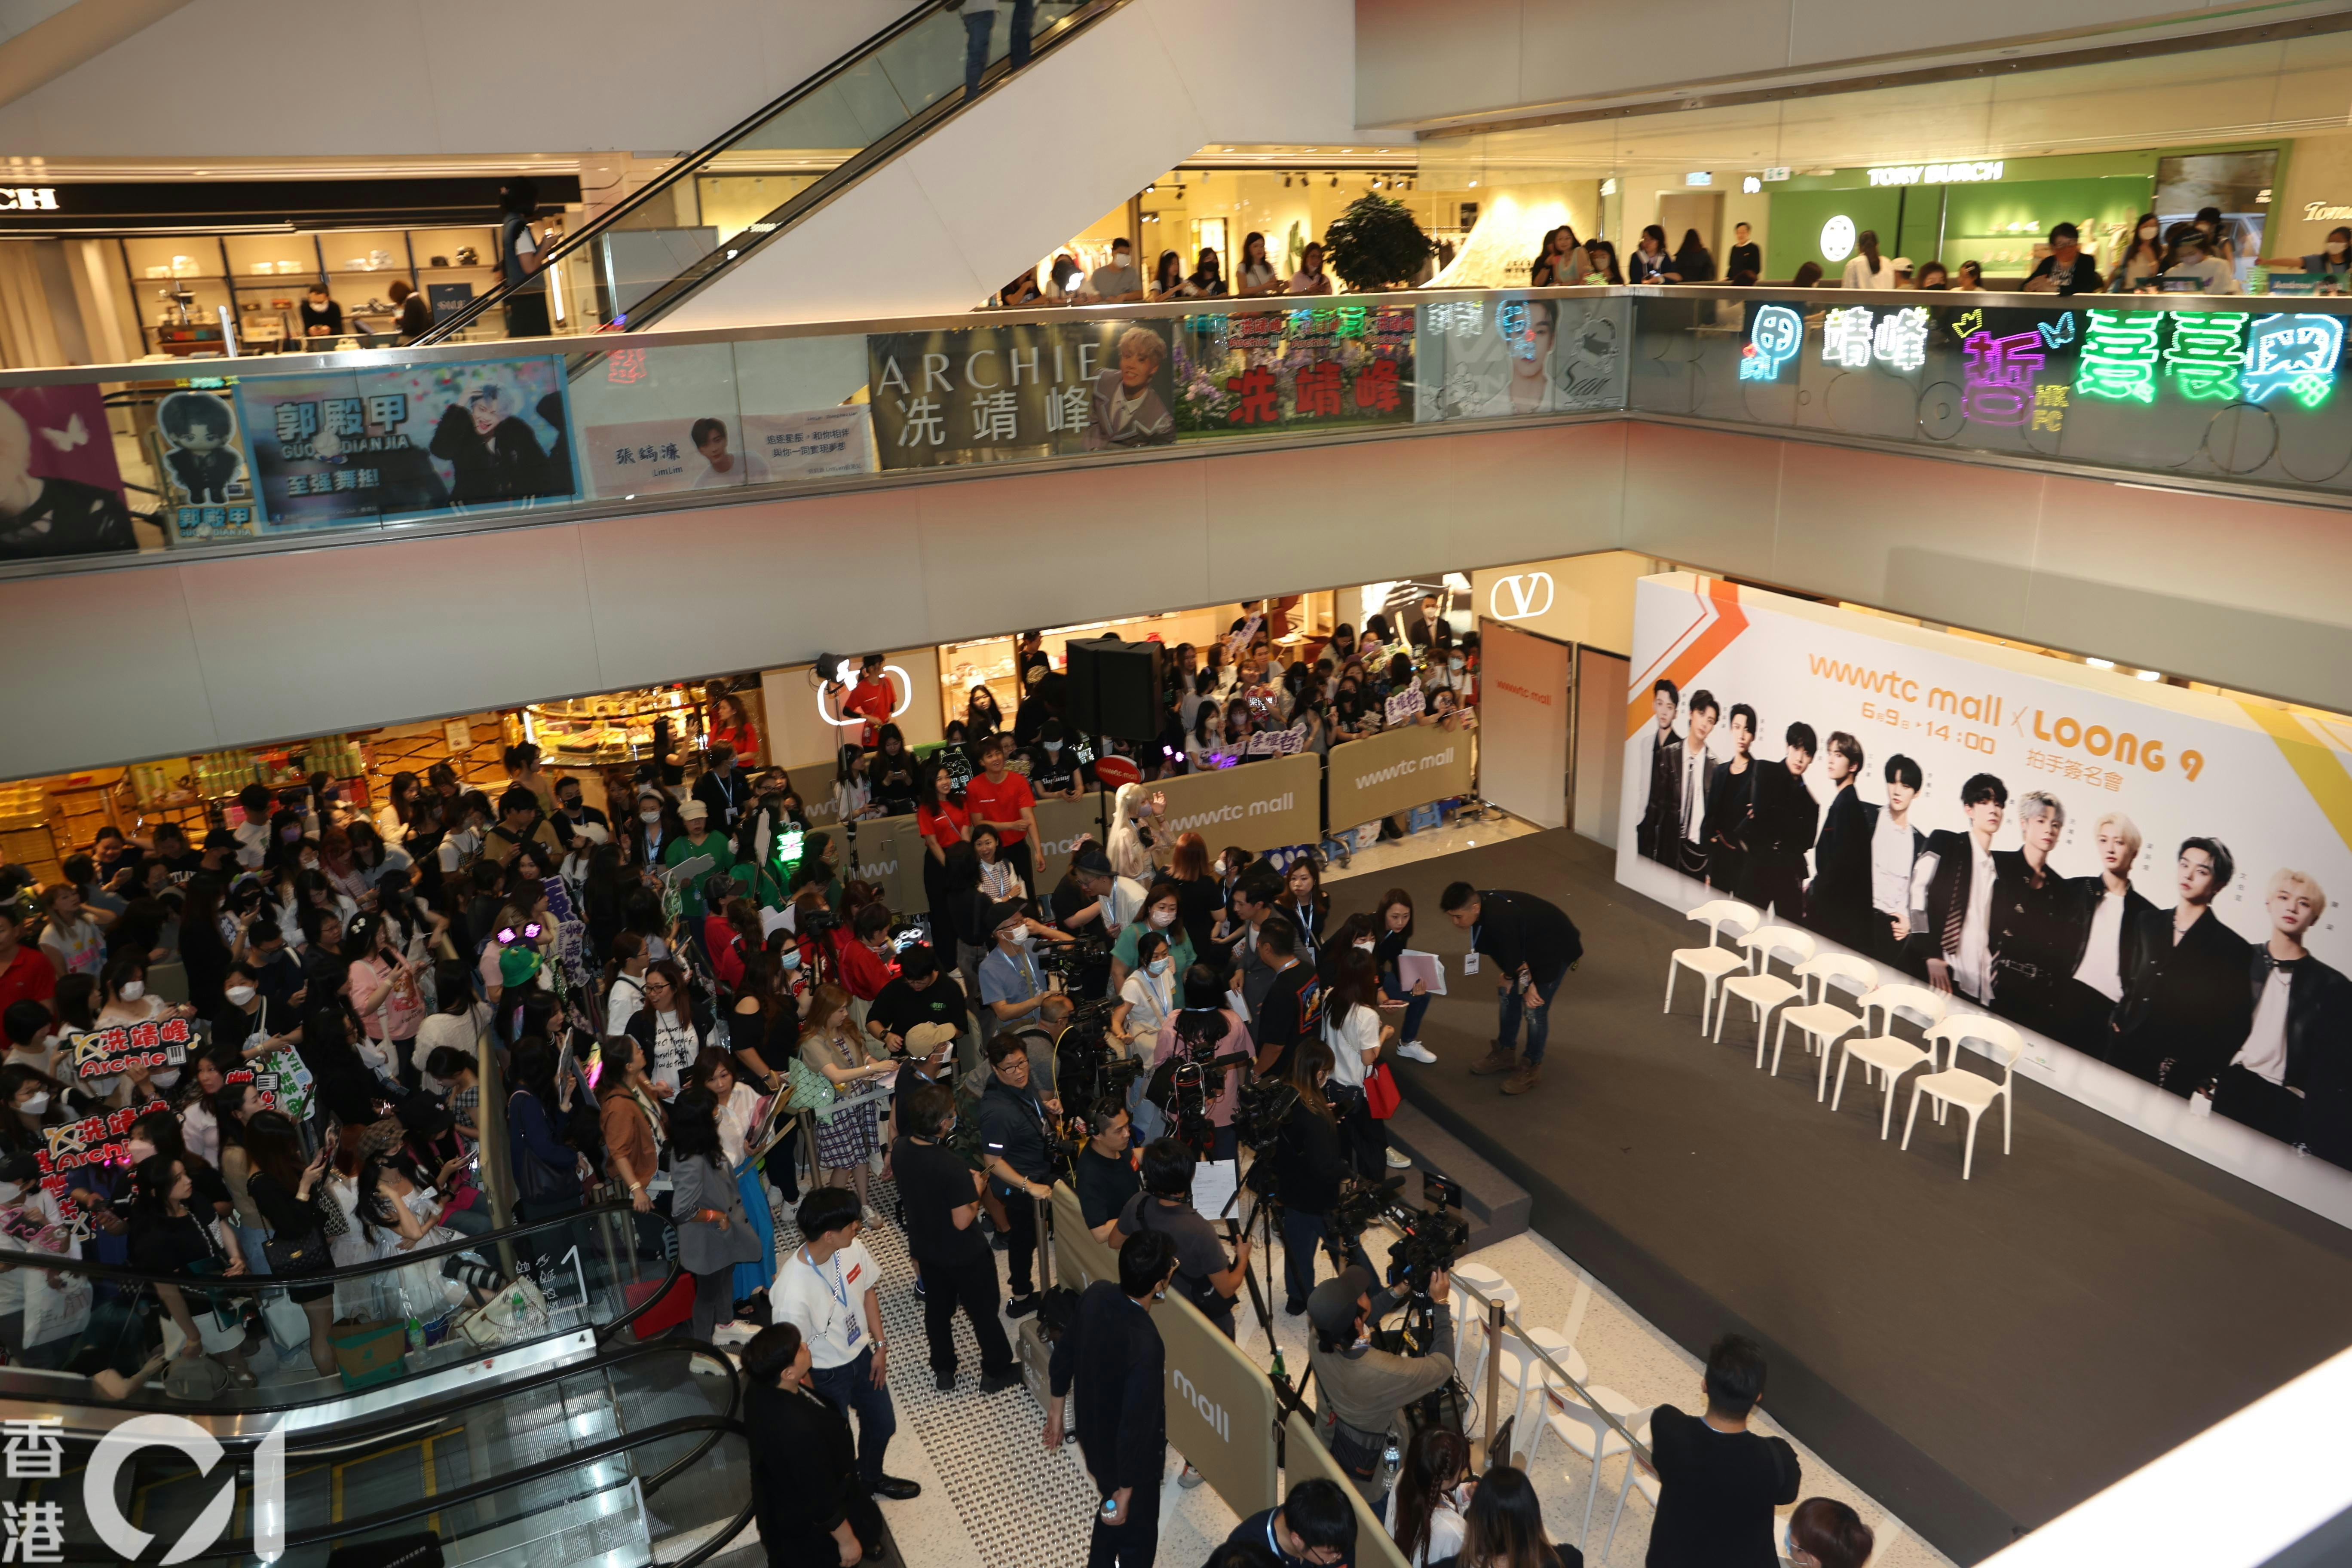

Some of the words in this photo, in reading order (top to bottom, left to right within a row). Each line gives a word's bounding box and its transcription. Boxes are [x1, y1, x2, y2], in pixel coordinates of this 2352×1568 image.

[1867, 166, 1924, 186] TORY
[1924, 161, 2003, 184] BURCH
[876, 343, 1104, 397] ARCHIE
[1227, 358, 1401, 423] 冼靖峰
[898, 386, 1091, 448] 冼靖峰
[282, 443, 316, 460] GUO
[653, 466, 683, 478] LimLim
[1531, 691, 1553, 706] mall
[1809, 652, 1920, 703] wwwtc
[1928, 686, 2003, 727] mall
[2034, 709, 2166, 773] LOONG
[2179, 748, 2205, 783] 9
[1355, 758, 1418, 790] wwwtc
[1419, 747, 1455, 770] mall
[1248, 791, 1294, 817] mall
[99, 1018, 190, 1053] 冼靖峰
[79, 1051, 167, 1078] Archie
[56, 1138, 130, 1172] Archi
[1173, 1369, 1229, 1443] mall
